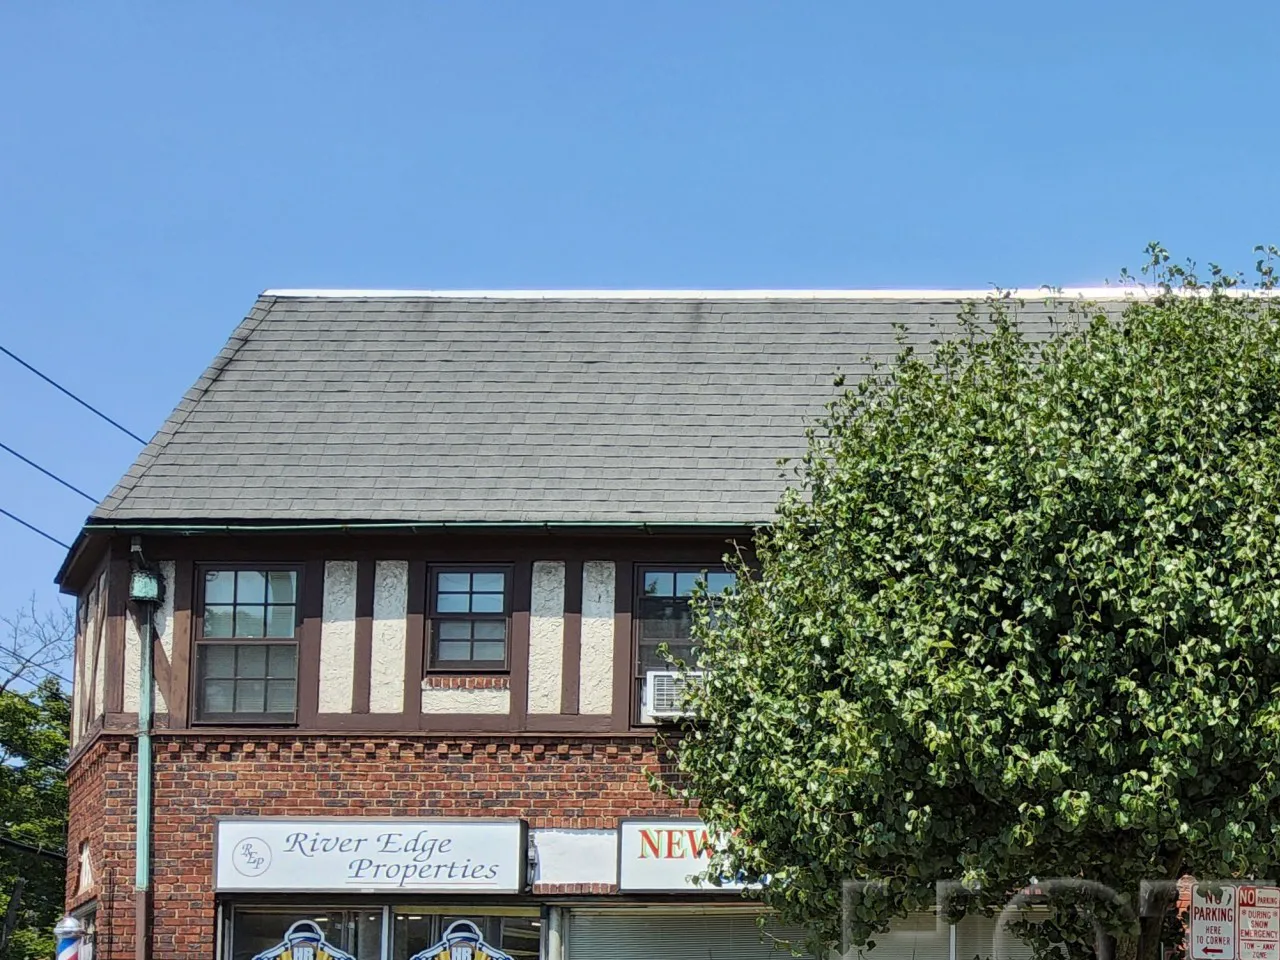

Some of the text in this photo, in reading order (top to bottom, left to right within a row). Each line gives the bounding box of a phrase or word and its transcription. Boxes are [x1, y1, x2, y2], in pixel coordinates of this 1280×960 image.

[283, 830, 452, 863] River Edge
[348, 858, 499, 887] Properties
[1240, 889, 1278, 905] NO PARKING
[1193, 906, 1233, 922] PARKING
[1248, 911, 1272, 920] DURING
[1250, 920, 1269, 929] SNOW
[1205, 925, 1222, 935] HERE
[1240, 929, 1278, 939] EMERGENCY
[1196, 935, 1231, 945] TO CORNER
